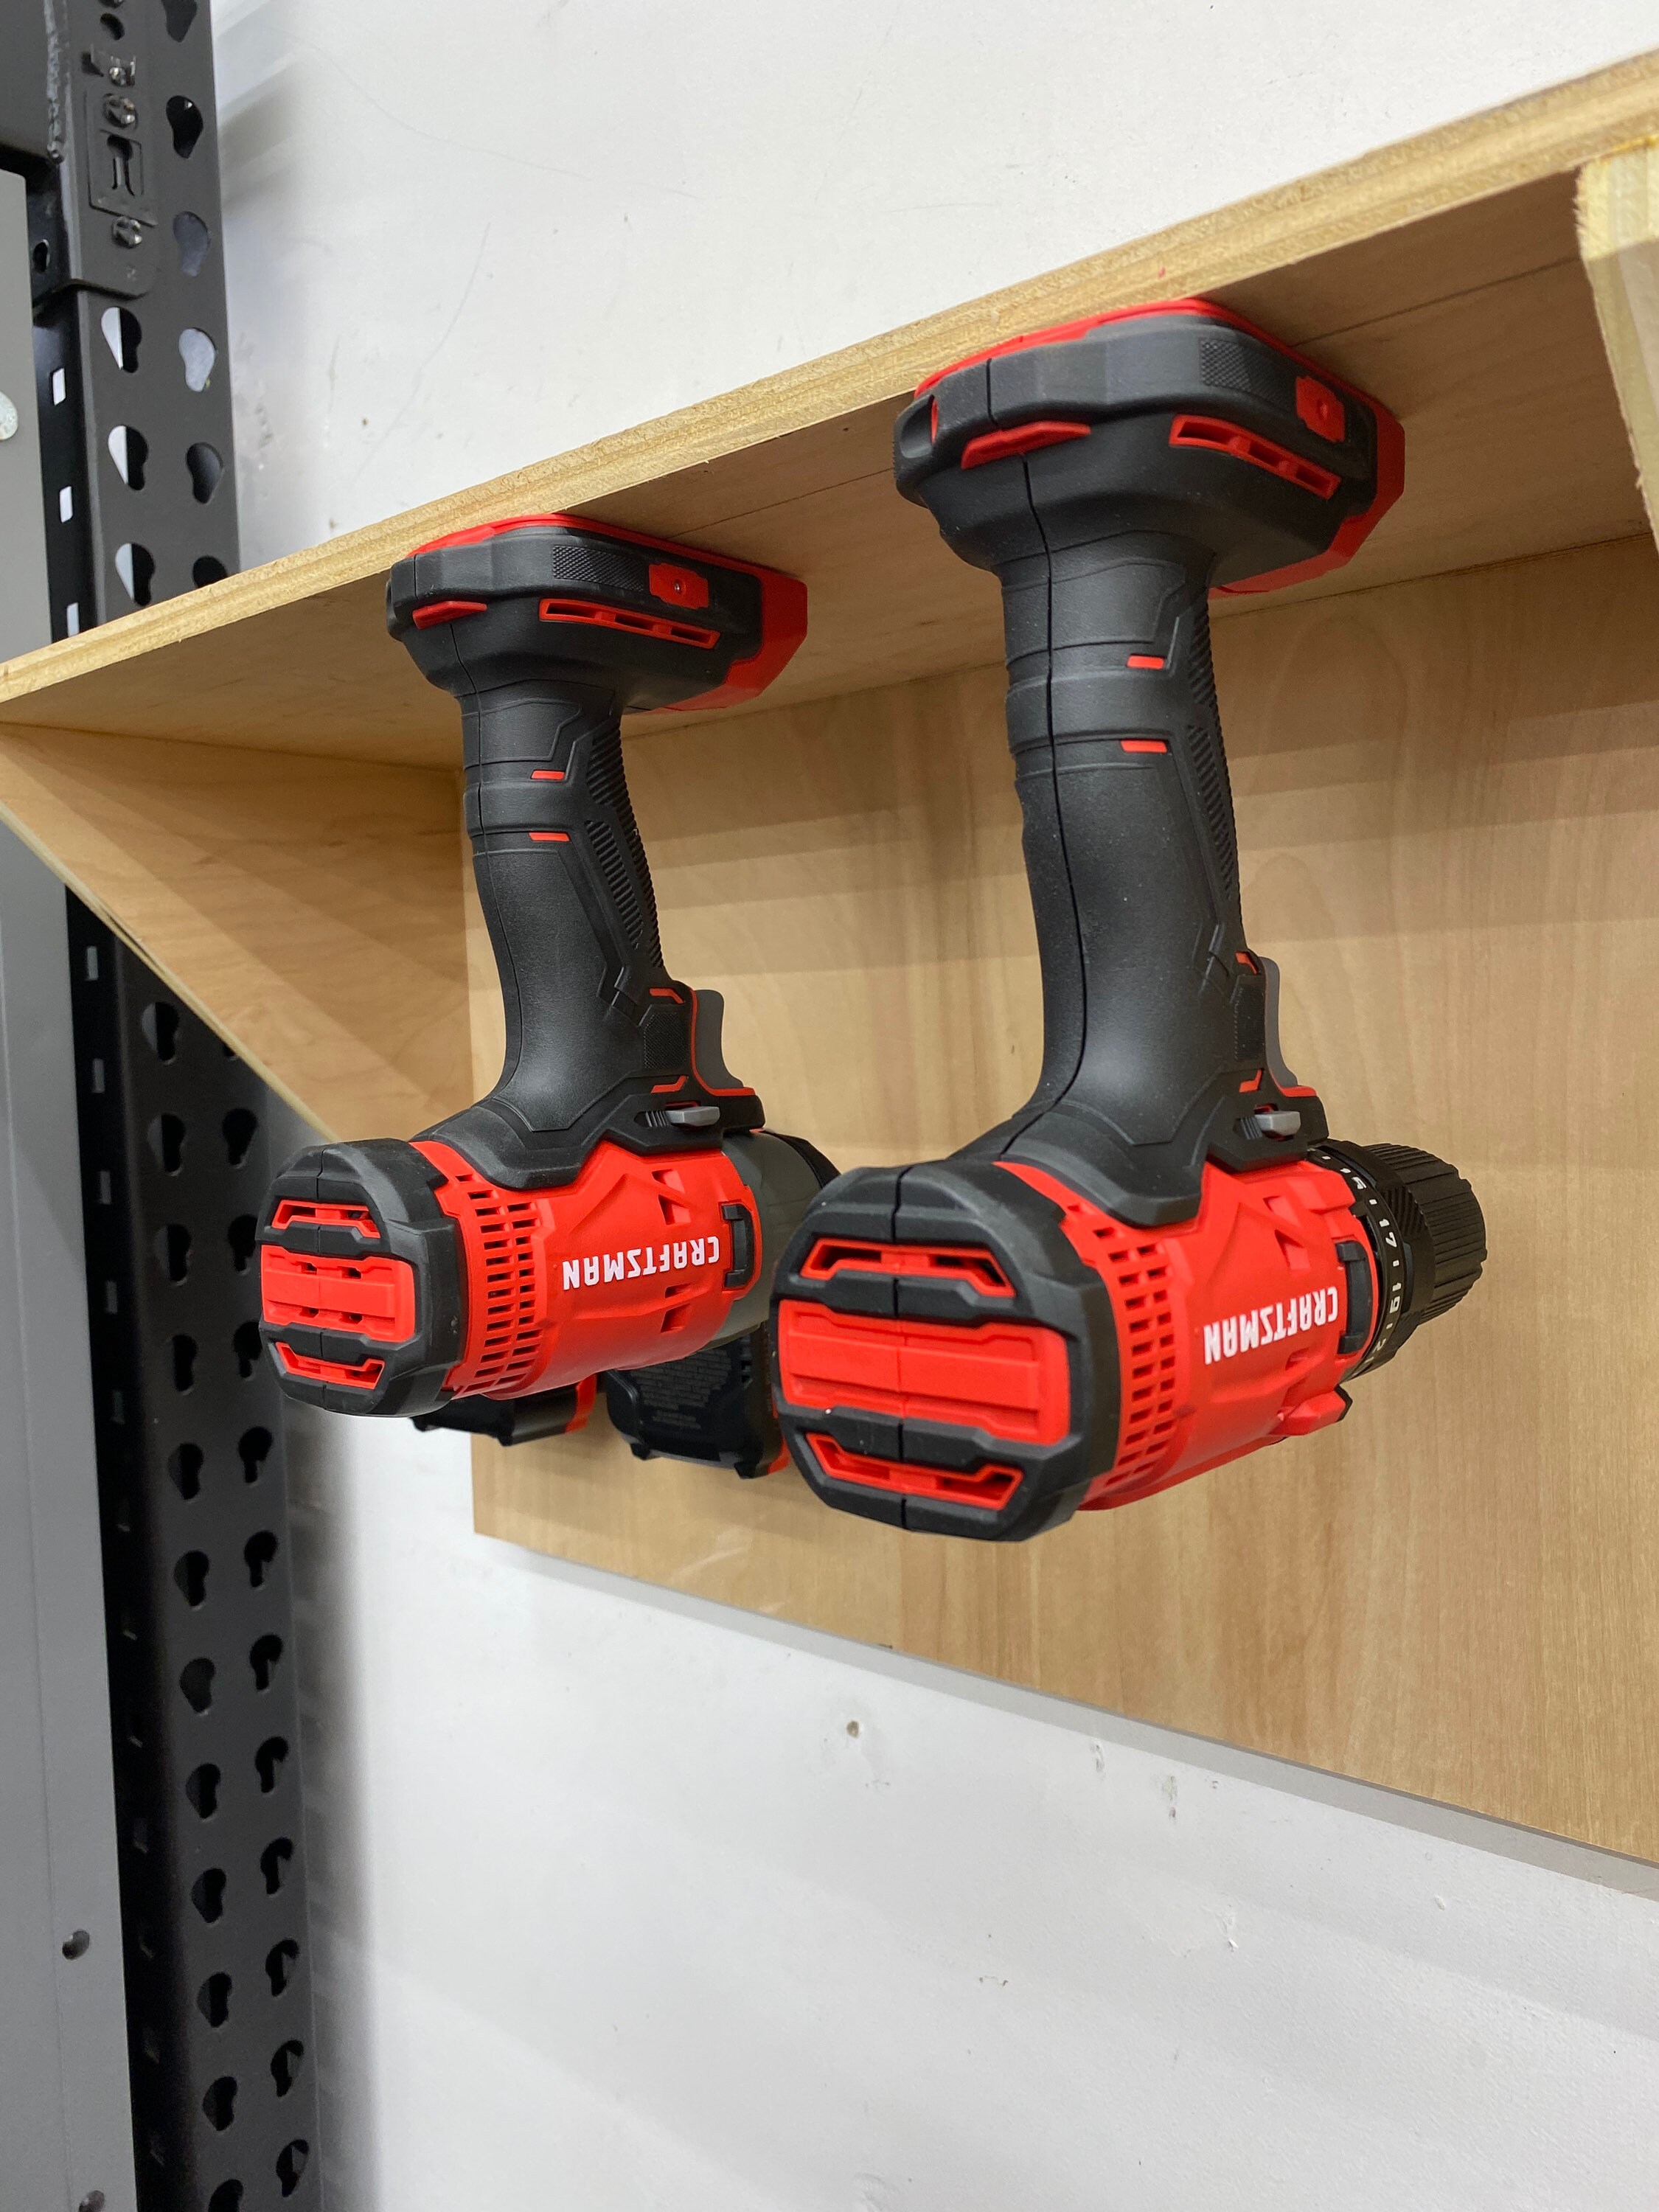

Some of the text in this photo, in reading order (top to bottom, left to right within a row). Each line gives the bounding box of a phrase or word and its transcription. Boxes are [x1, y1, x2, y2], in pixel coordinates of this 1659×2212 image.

[563, 1236, 720, 1290] CRAFTSMAN
[1379, 1218, 1397, 1248] 17
[1389, 1282, 1402, 1314] 19
[1203, 1286, 1338, 1365] CRAFTSMAN
